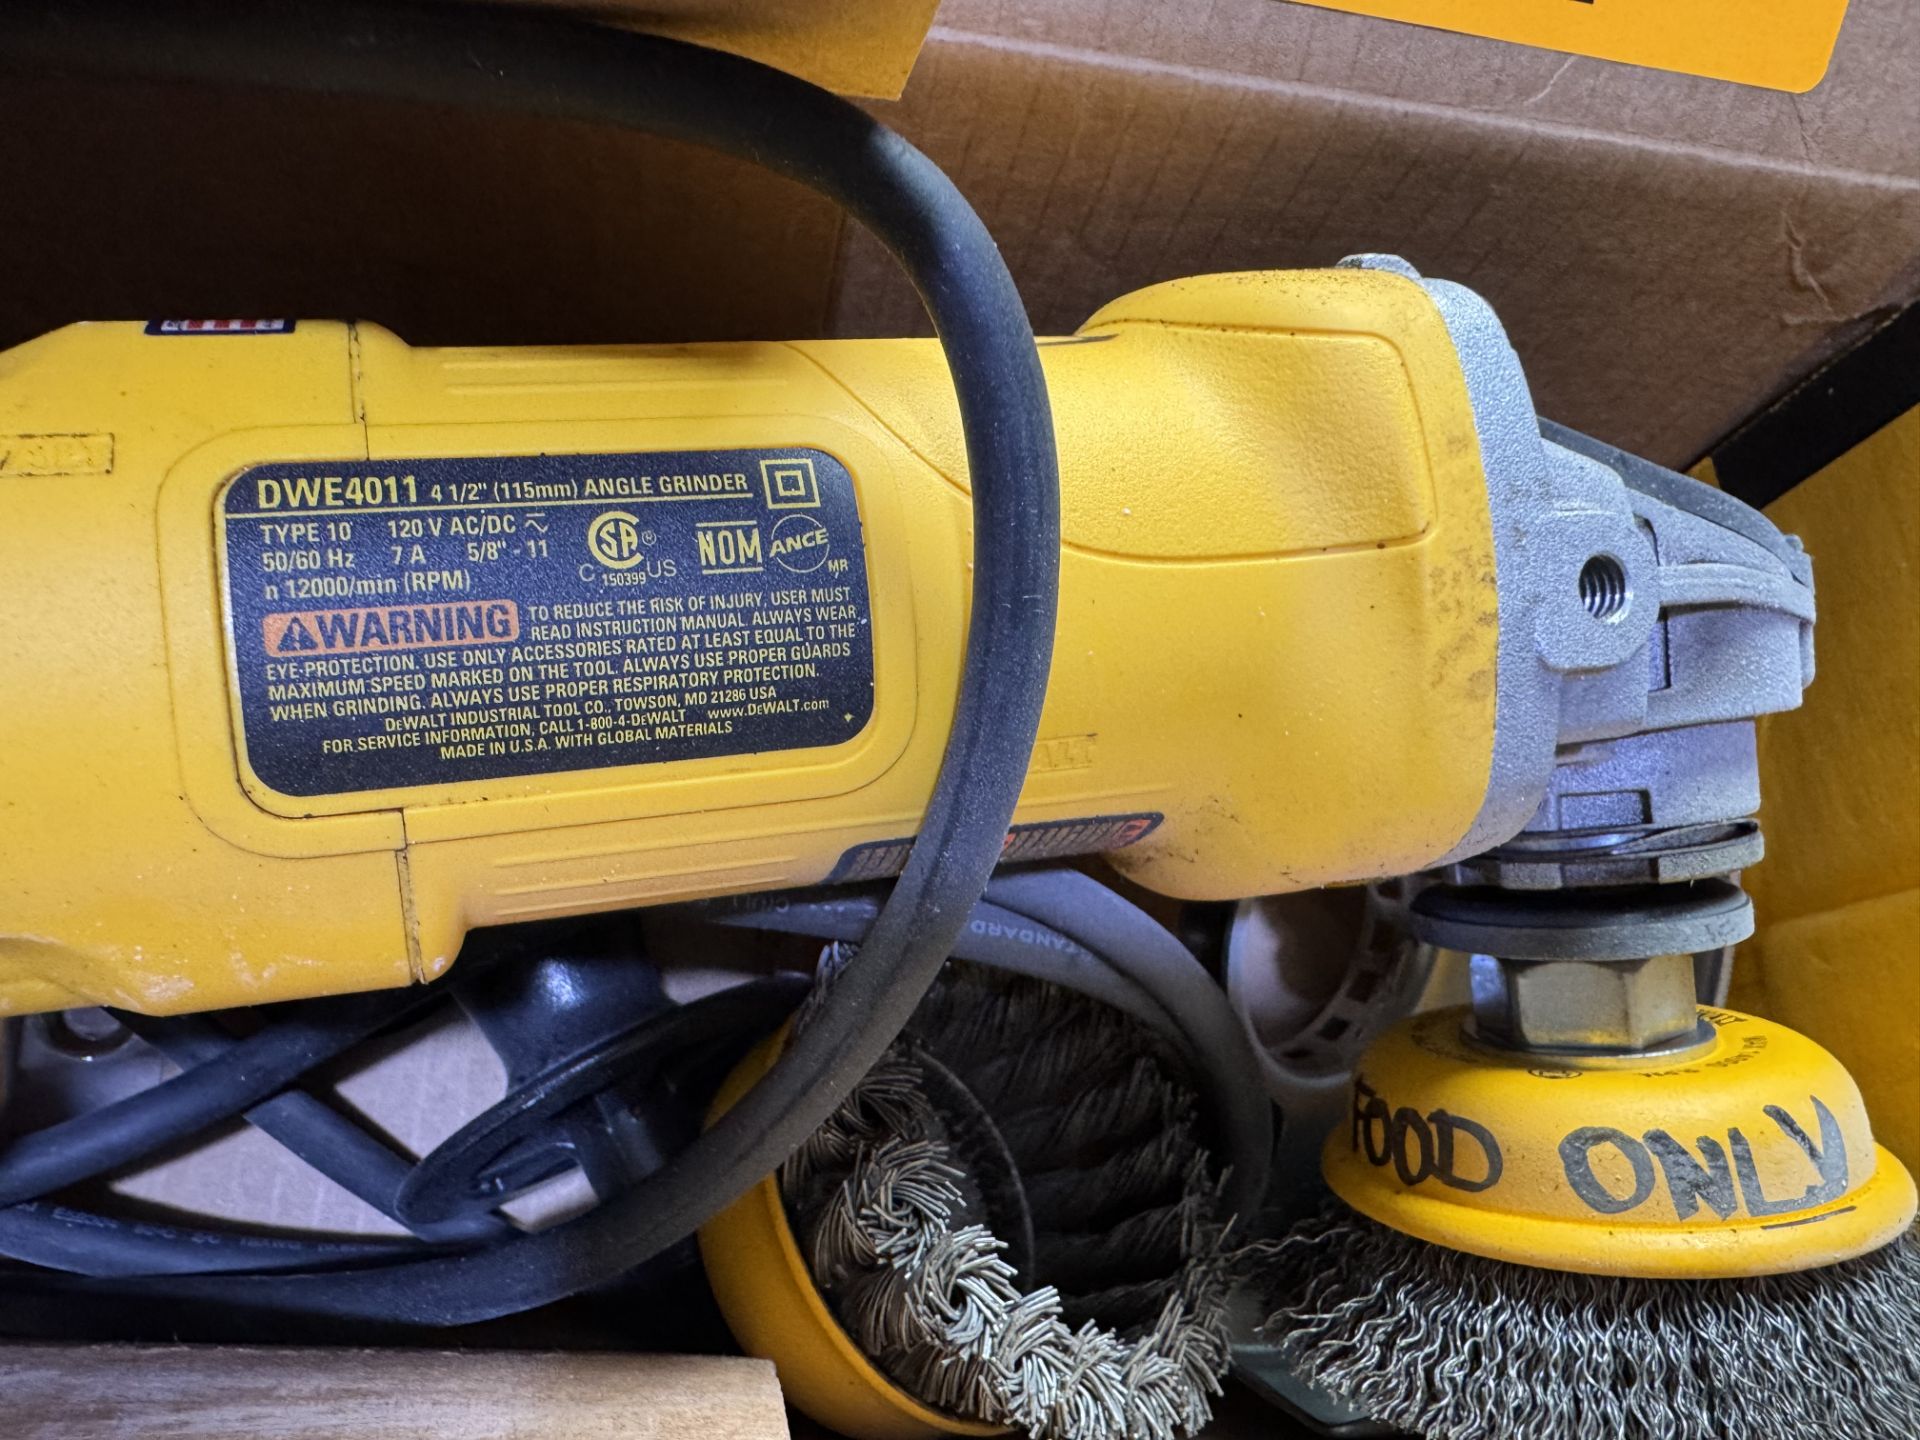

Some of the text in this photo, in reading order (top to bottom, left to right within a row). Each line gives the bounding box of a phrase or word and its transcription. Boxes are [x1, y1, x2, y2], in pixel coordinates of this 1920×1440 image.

[258, 474, 748, 508] DWE4011 4 1/2" (115mm) ANGLE GRINDER
[260, 514, 515, 544] TYPE 10 120 V AC/DC
[698, 526, 763, 567] NOM
[769, 528, 829, 558] ANCE
[262, 550, 321, 572] 50/60
[328, 549, 355, 568] Hz
[392, 548, 402, 564] 7
[411, 546, 426, 564] A
[468, 541, 506, 562] 5/8"
[528, 540, 548, 558] 11
[602, 571, 646, 586] 150399
[648, 559, 677, 578] US
[828, 559, 849, 573] MR
[265, 570, 470, 600] n 12000/min (RPM)
[529, 604, 548, 622] TO
[554, 601, 613, 618] REDUCE
[618, 600, 646, 616] THE
[650, 597, 684, 614] RISK
[689, 596, 706, 612] OF
[771, 590, 807, 607] USER
[812, 587, 851, 603] MUST
[532, 624, 570, 642] READ
[576, 616, 678, 639] INSTRUCTION
[752, 608, 812, 626] ALWAYS
[816, 604, 856, 621] WEAR
[315, 603, 512, 650] WARNING
[266, 622, 856, 681] EYE PROTECTION. USE ONLY ACCESSORIES RATED AT LEAST EQUAL TO THE
[268, 642, 852, 700] MAXIMUM SPEED MARKED ON THE TOOL. ALWAYS USE PROPER GUARDS
[270, 664, 820, 722] WHEN GRINDING. ALWAYS USE PROPER RESPIRATORY PROTECTION.
[451, 705, 540, 726] INDUSTRIAL
[544, 703, 582, 718] TOOL
[615, 694, 682, 712] TOWSON,
[685, 692, 708, 707] MD
[710, 689, 746, 706] 21286
[750, 686, 777, 701] USA
[322, 740, 352, 754] FOR
[358, 734, 420, 752] SERVICE
[539, 718, 573, 734] CALL
[441, 720, 733, 760] MADE IN U.S.A. WITH GLOBAL MATERIALS
[1352, 1071, 1850, 1222] FOOD ONLY
